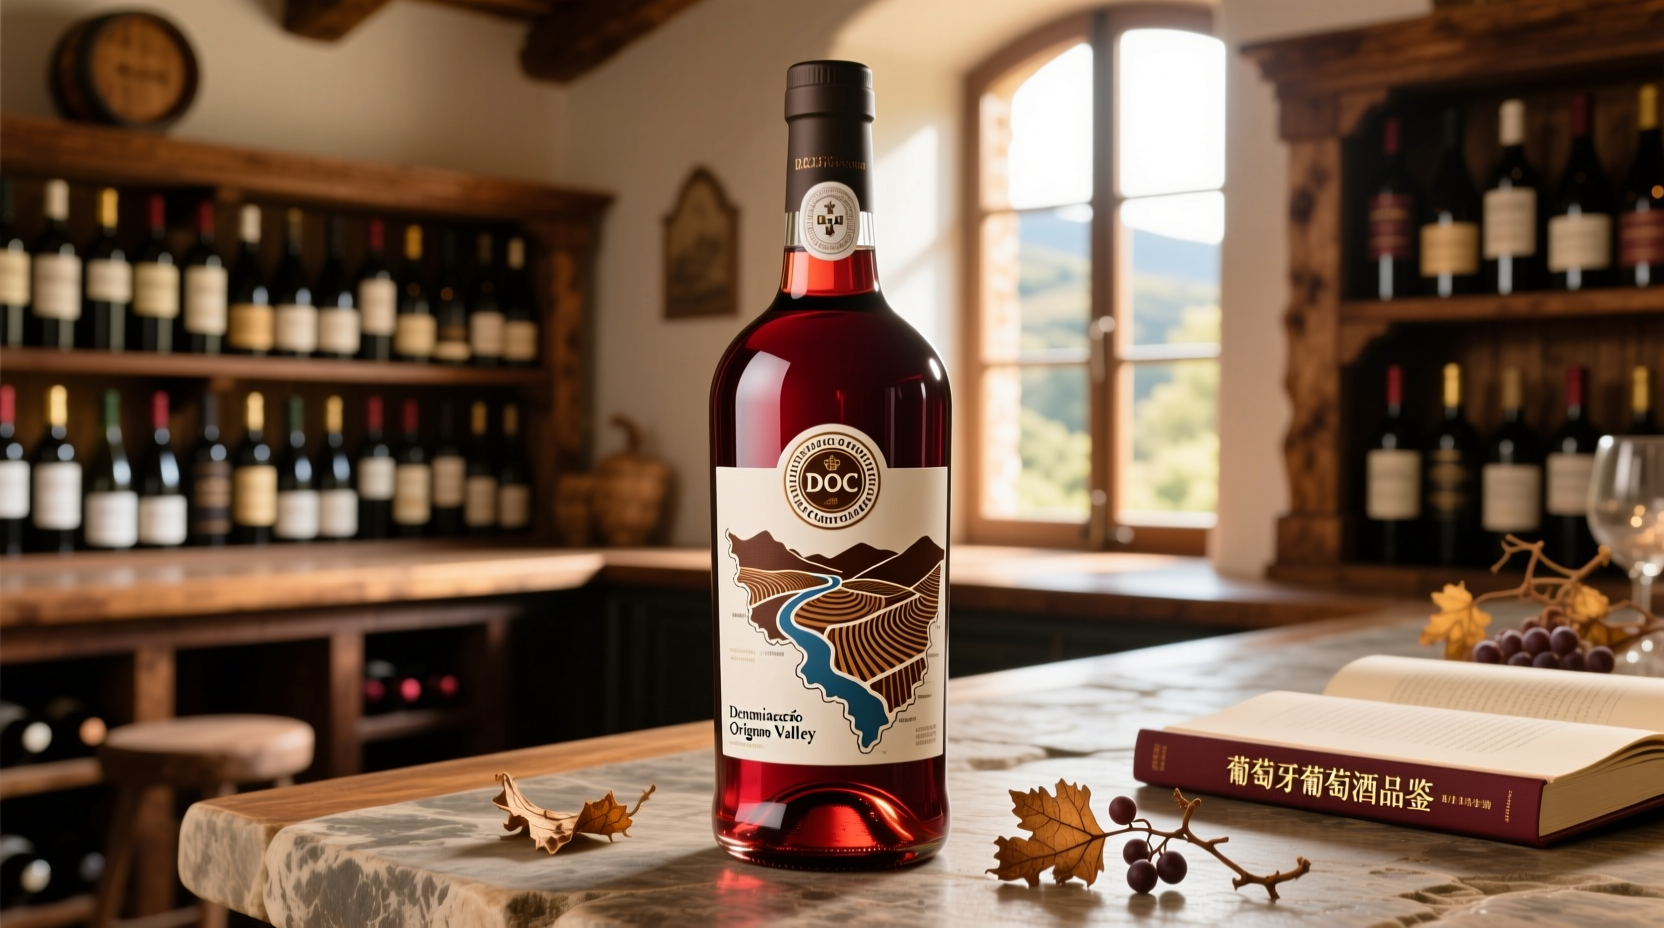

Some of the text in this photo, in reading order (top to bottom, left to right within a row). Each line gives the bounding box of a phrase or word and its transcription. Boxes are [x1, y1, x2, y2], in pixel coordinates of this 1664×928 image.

[805, 473, 858, 493] DOC
[774, 724, 816, 745] Valley
[1227, 755, 1434, 812] 葡萄牙葡萄酒品鉴
